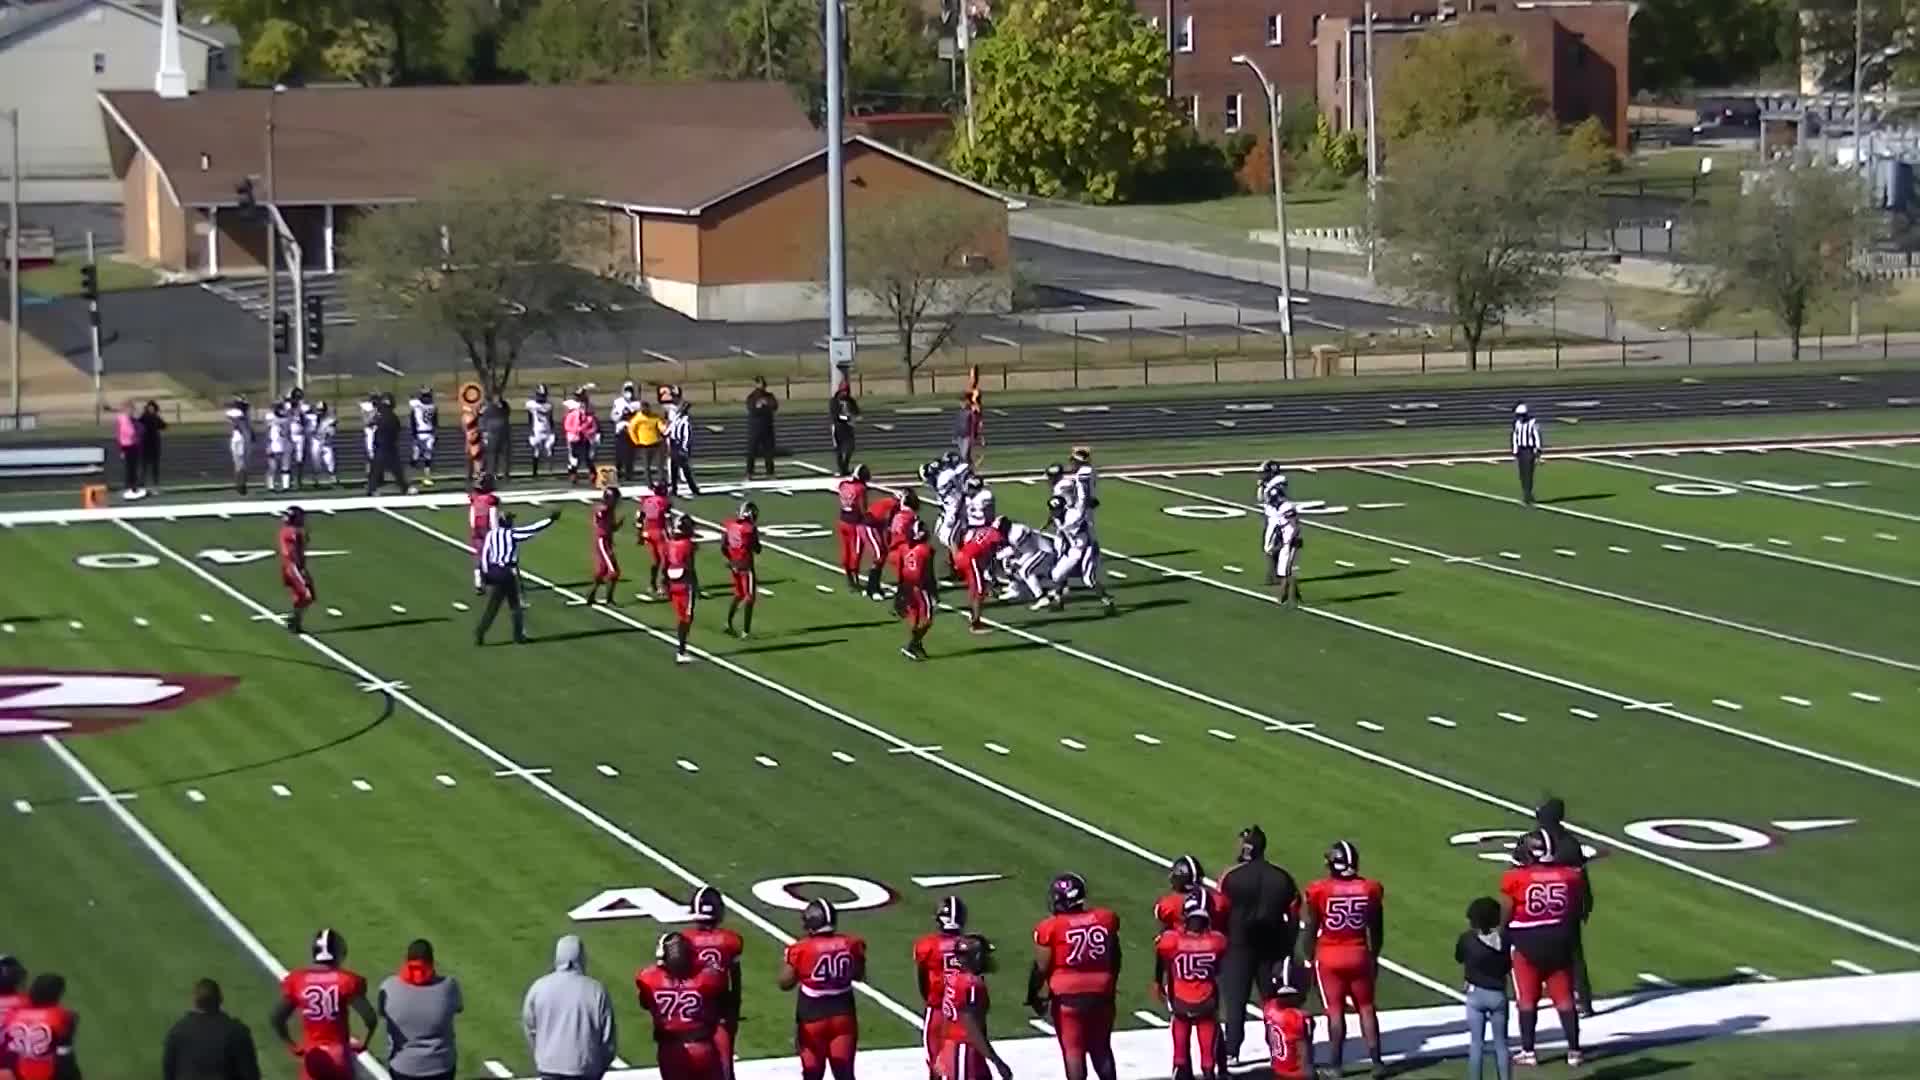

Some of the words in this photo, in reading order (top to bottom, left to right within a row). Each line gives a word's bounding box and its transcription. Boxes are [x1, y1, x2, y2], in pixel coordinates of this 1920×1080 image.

[568, 875, 893, 923] 40
[1326, 896, 1368, 930] 55
[1526, 883, 1568, 916] 65
[1066, 925, 1108, 965] 79
[811, 951, 853, 981] 40
[1175, 952, 1215, 980] 15
[302, 984, 339, 1020] 31
[654, 990, 702, 1023] 72
